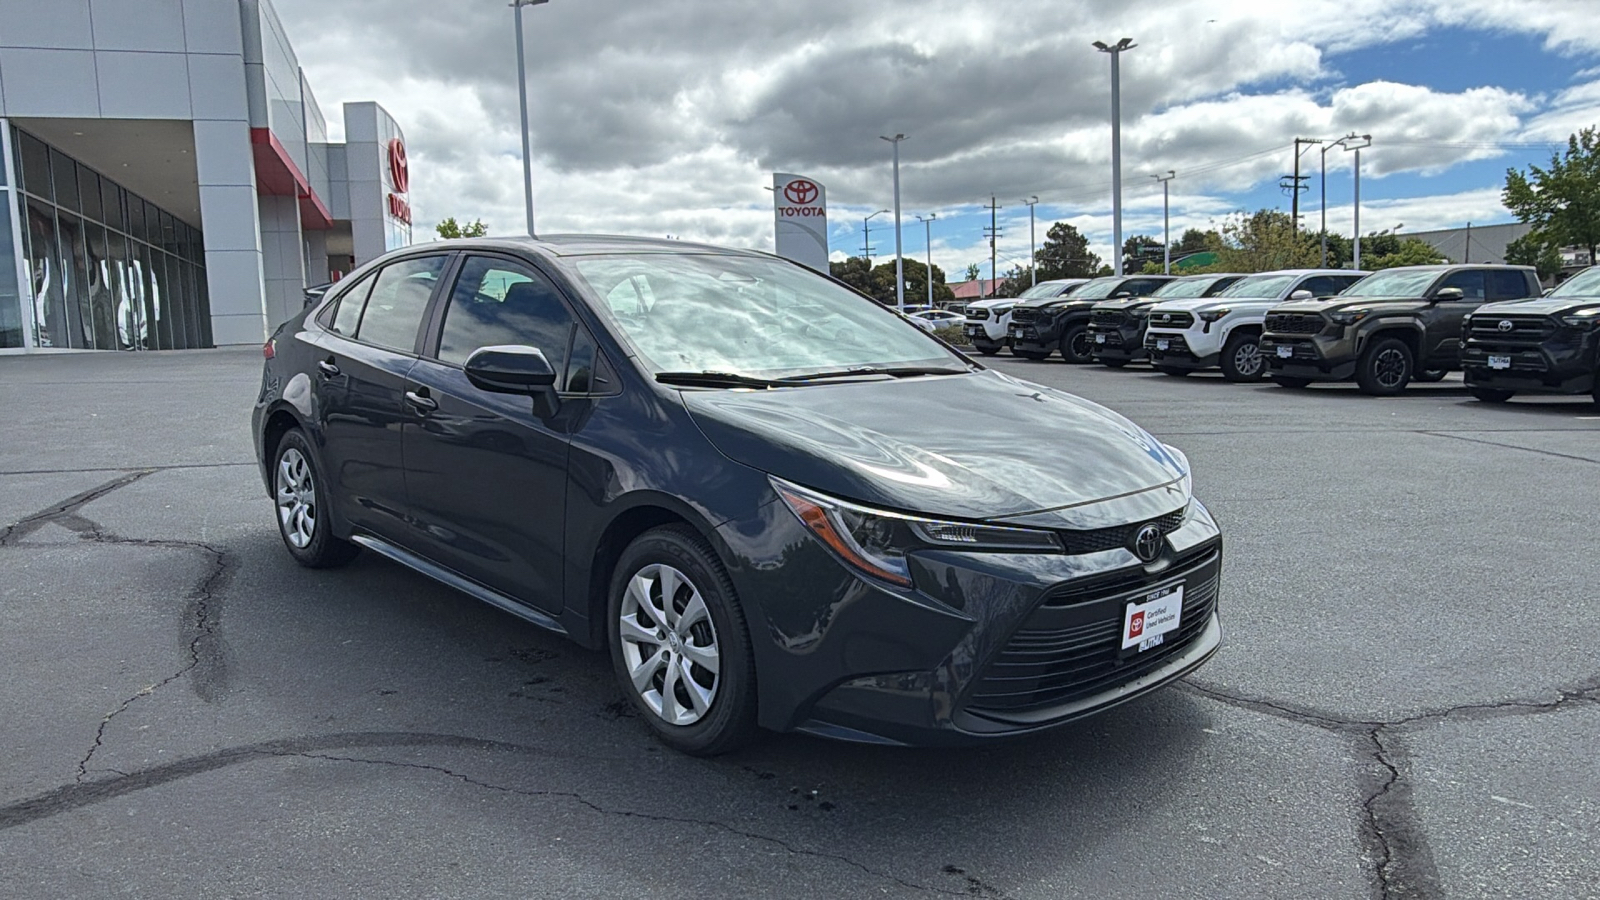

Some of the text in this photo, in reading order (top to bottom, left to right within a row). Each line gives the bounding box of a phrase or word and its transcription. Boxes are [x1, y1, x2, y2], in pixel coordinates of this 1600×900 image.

[388, 193, 412, 226] TOYO
[778, 207, 825, 217] TOYOTA
[1147, 606, 1167, 619] Certified
[1146, 614, 1175, 629] Used Vehicles
